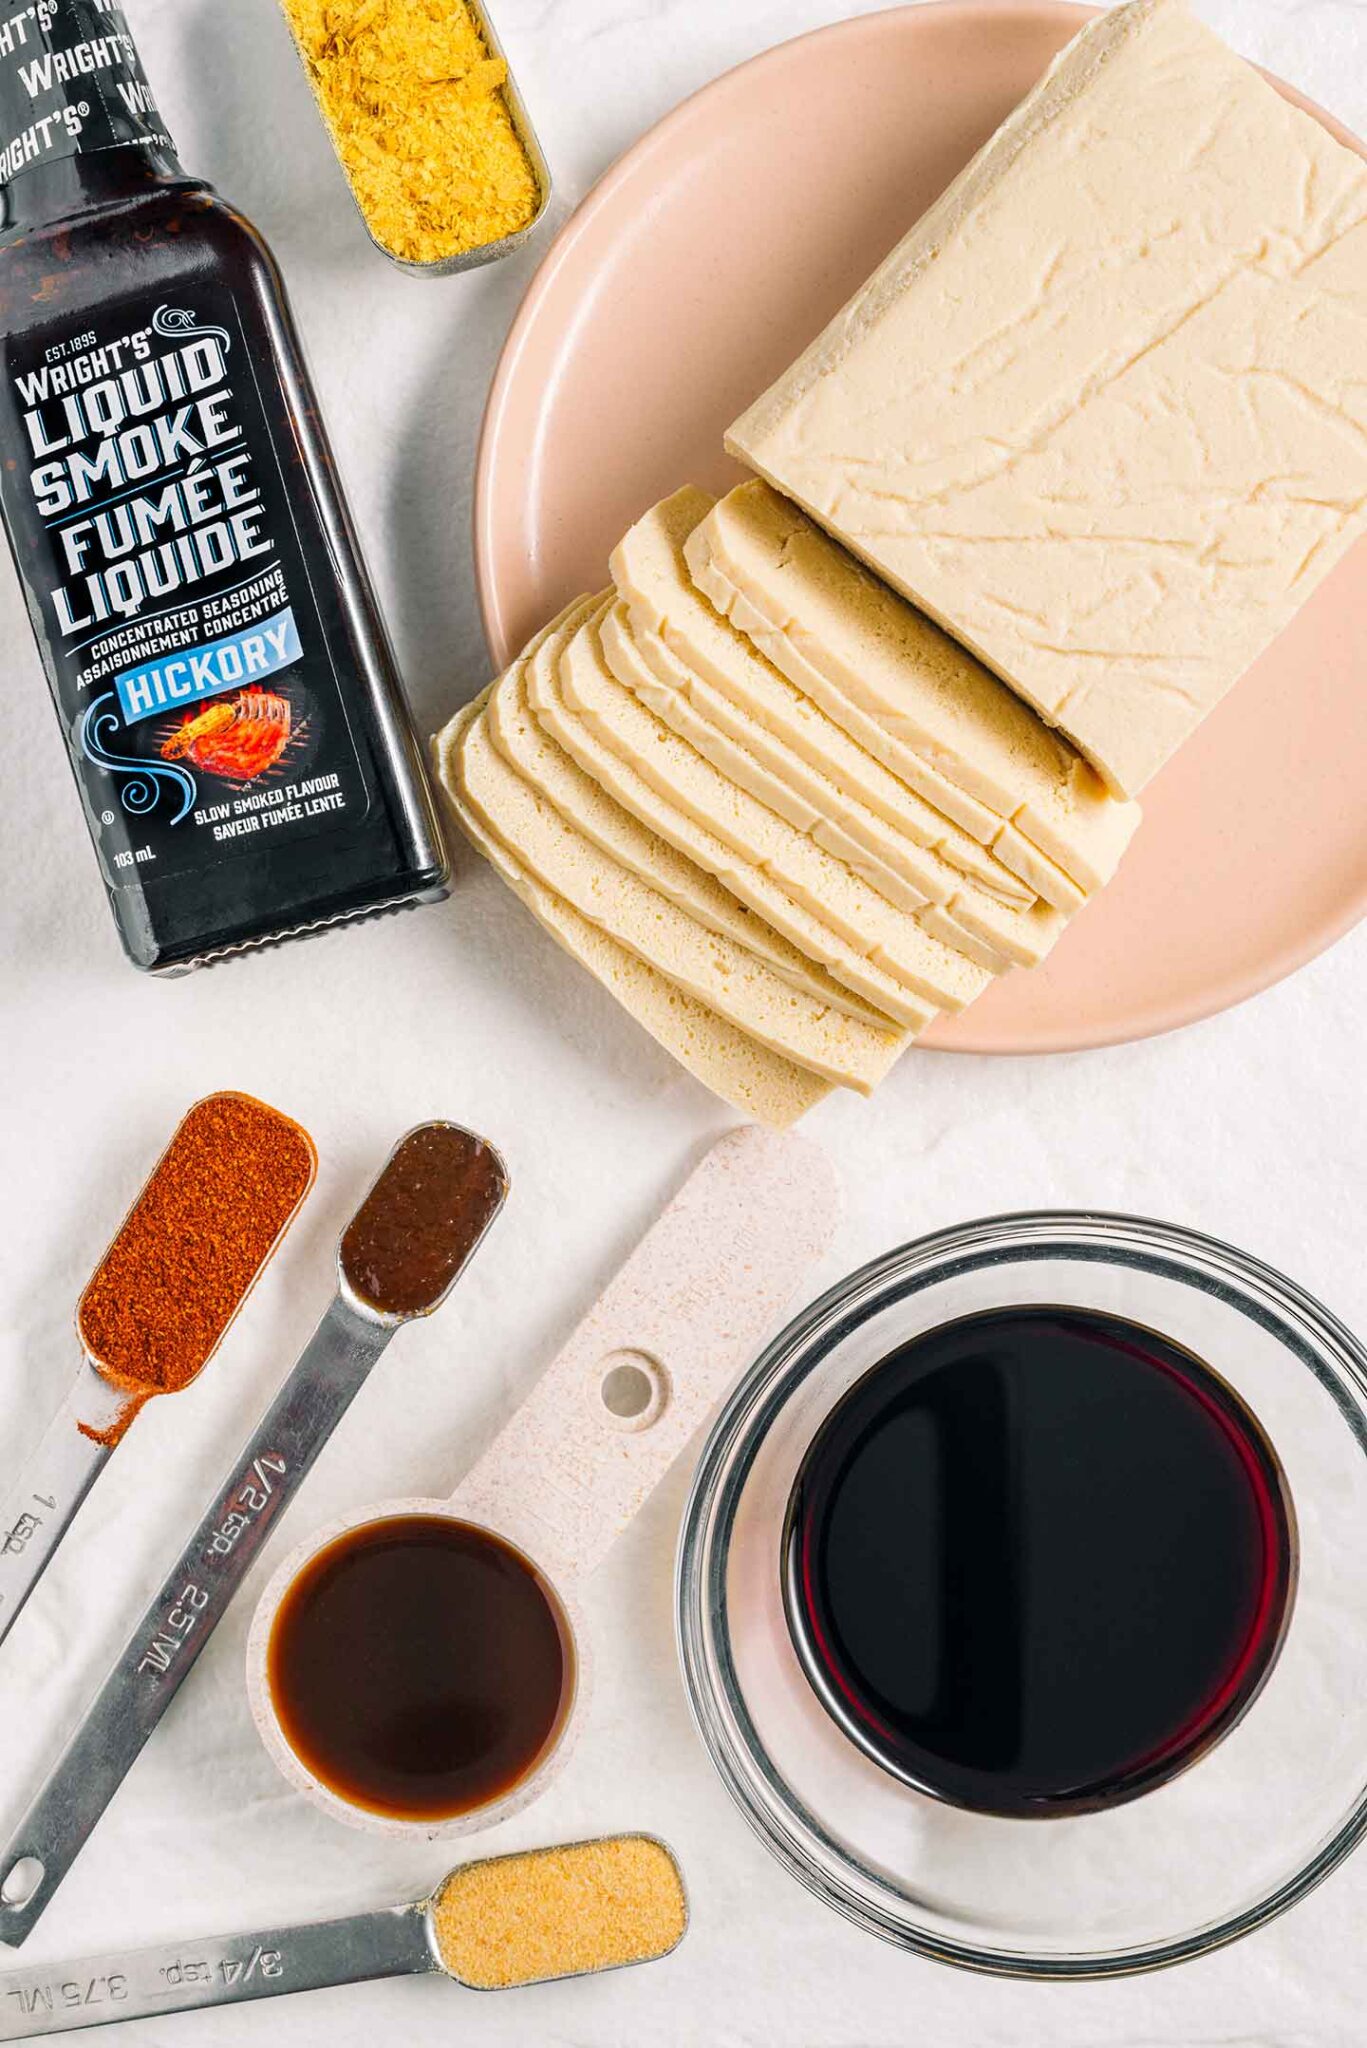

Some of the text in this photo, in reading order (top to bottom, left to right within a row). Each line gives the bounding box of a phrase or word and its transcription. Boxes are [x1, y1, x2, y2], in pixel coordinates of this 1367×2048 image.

[23, 337, 228, 459] LIQUID
[29, 389, 242, 516] SMOKE
[59, 453, 261, 575] FUMÉE
[50, 504, 275, 636] LIQUIDE
[90, 568, 284, 659] CONCENTRATED SEASONING
[75, 584, 289, 691] ASSAISONNEMENT CONCENTRÉ
[124, 620, 289, 715] HICKORY
[194, 773, 340, 826] SLOW SMOKED FLAVOUR
[213, 793, 346, 841] SAVEUR FUMÉE LENTE
[113, 845, 156, 869] 103 mL
[137, 1457, 286, 1674] 1/2 tsp. 2.5 ML
[7, 1945, 284, 2014] 3/4 tsp. 3.75 ML
